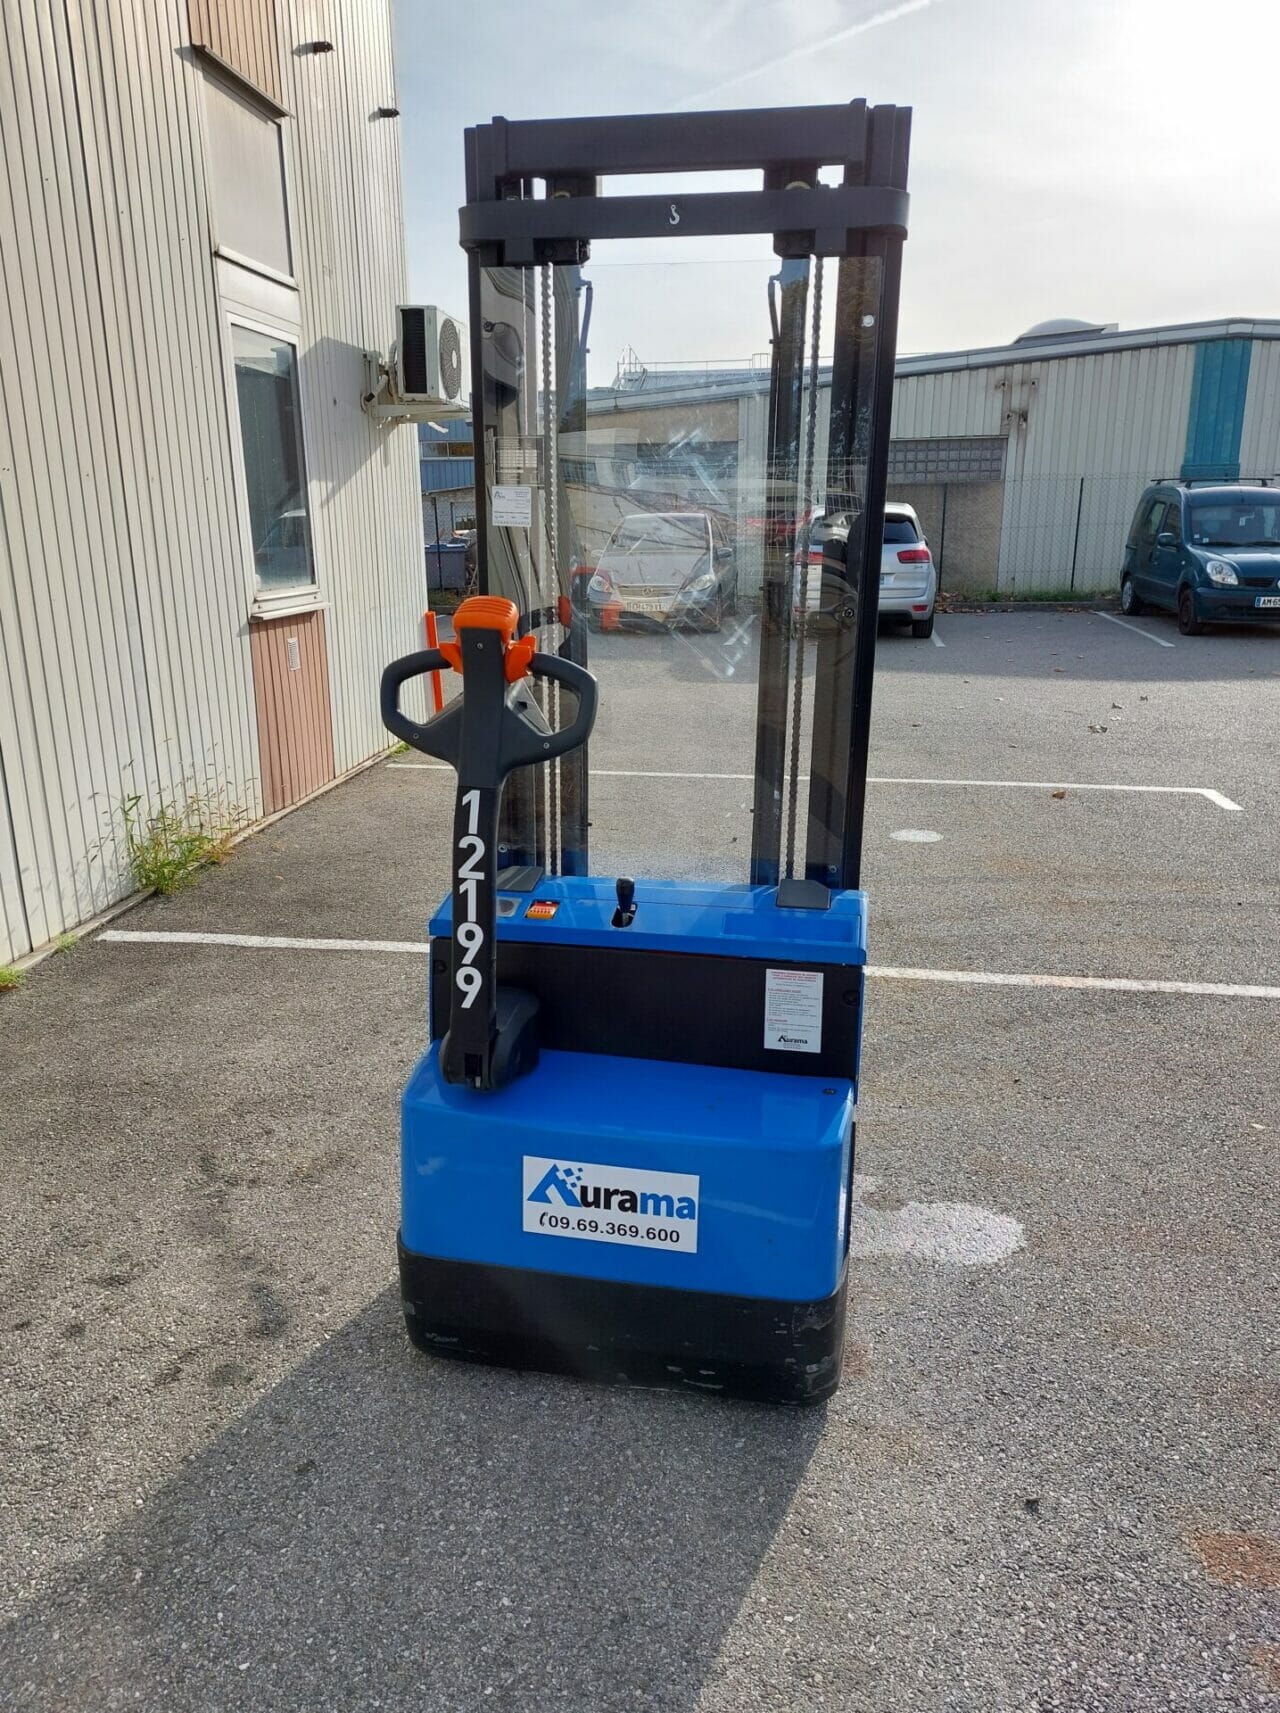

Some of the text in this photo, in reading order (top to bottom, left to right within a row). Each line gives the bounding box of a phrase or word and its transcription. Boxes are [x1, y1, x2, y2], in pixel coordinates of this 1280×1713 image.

[455, 789, 485, 1009] 12199
[527, 1163, 696, 1220] Aurama
[548, 1214, 680, 1243] 09.69.369.600
